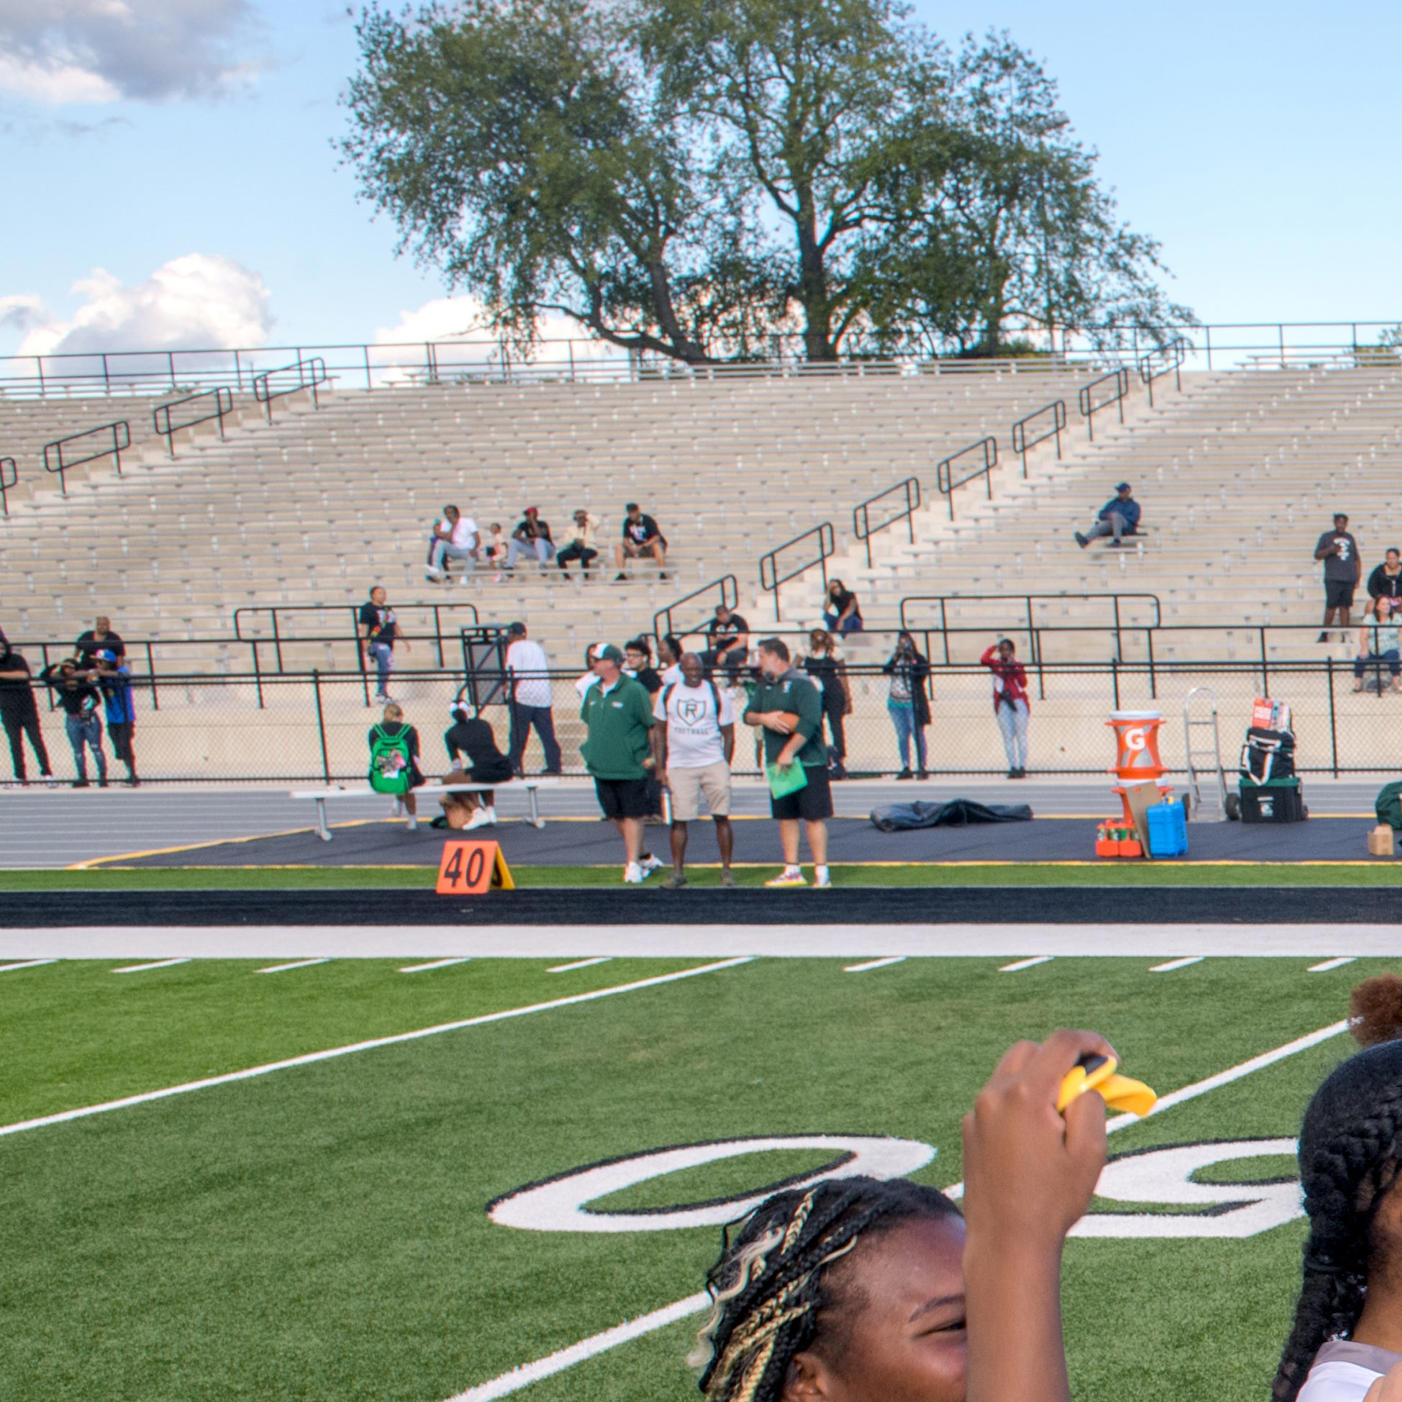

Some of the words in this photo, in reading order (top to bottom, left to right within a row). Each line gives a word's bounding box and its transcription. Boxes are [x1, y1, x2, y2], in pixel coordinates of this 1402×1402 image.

[685, 702, 697, 719] R
[1125, 728, 1146, 750] G
[443, 847, 485, 888] 40
